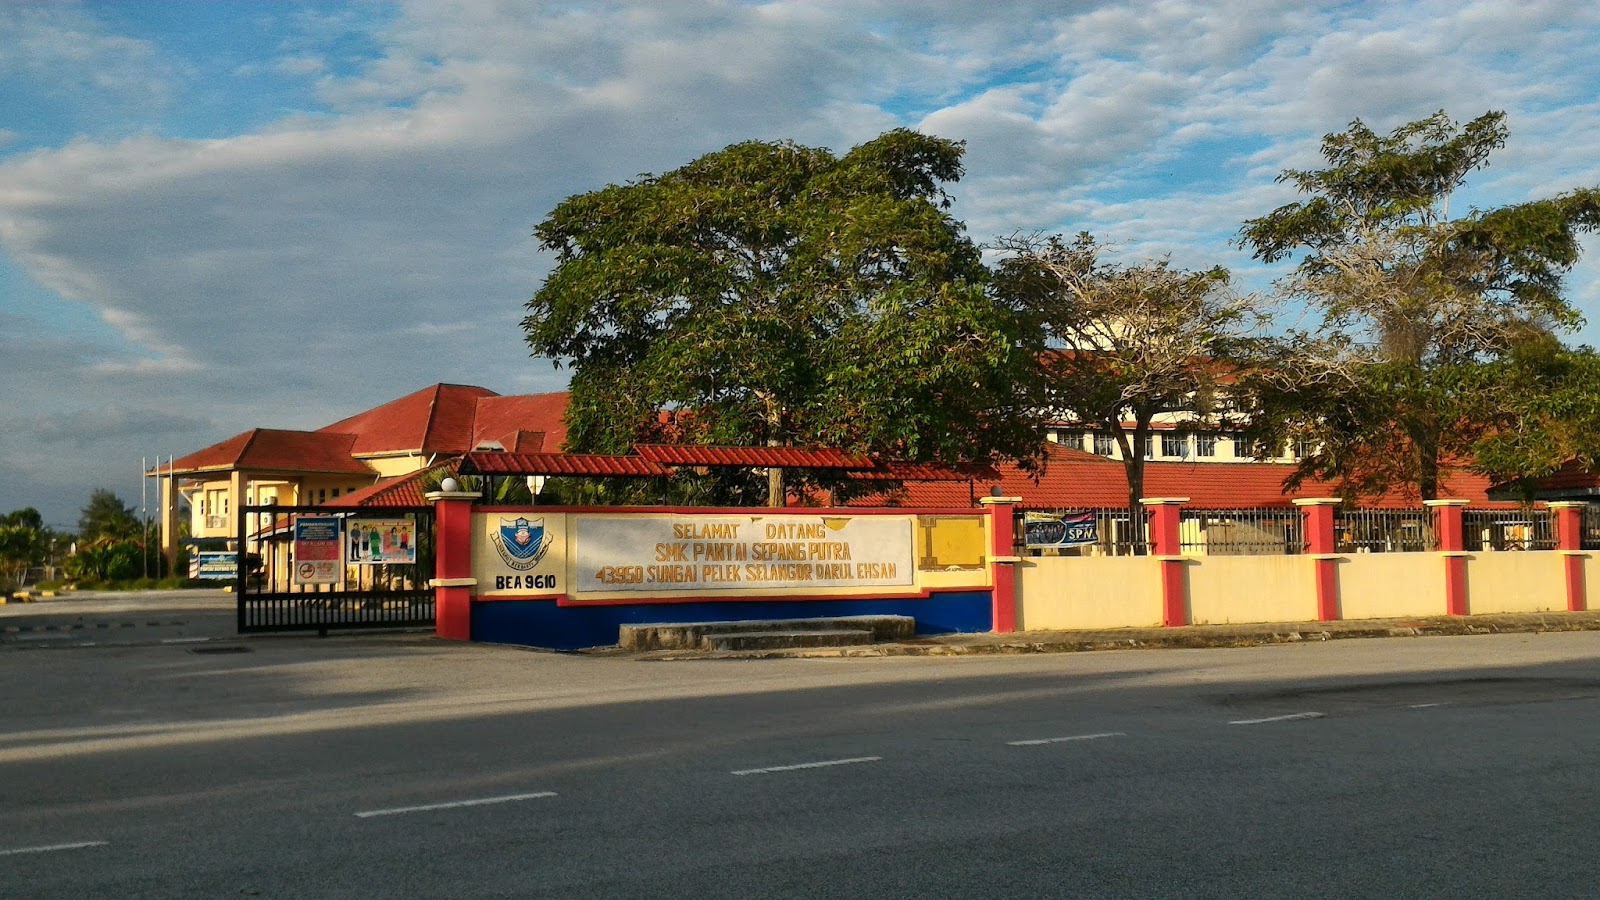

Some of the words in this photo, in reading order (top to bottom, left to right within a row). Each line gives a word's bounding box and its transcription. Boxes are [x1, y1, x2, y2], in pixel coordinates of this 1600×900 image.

[672, 523, 740, 540] SELAMAT
[765, 523, 826, 540] DATANG
[655, 542, 689, 562] SMK
[693, 542, 747, 562] PANTAI
[751, 542, 806, 561] SEPANG
[808, 542, 851, 561] PUTRA
[496, 575, 522, 590] BEA
[525, 574, 556, 589] 9610
[595, 565, 644, 585] 43950
[646, 564, 698, 583] SUNGAI
[702, 564, 742, 582] PELEK
[745, 563, 813, 582] SELANGOR
[815, 562, 854, 580] DARUL
[856, 562, 897, 579] EHSAN
